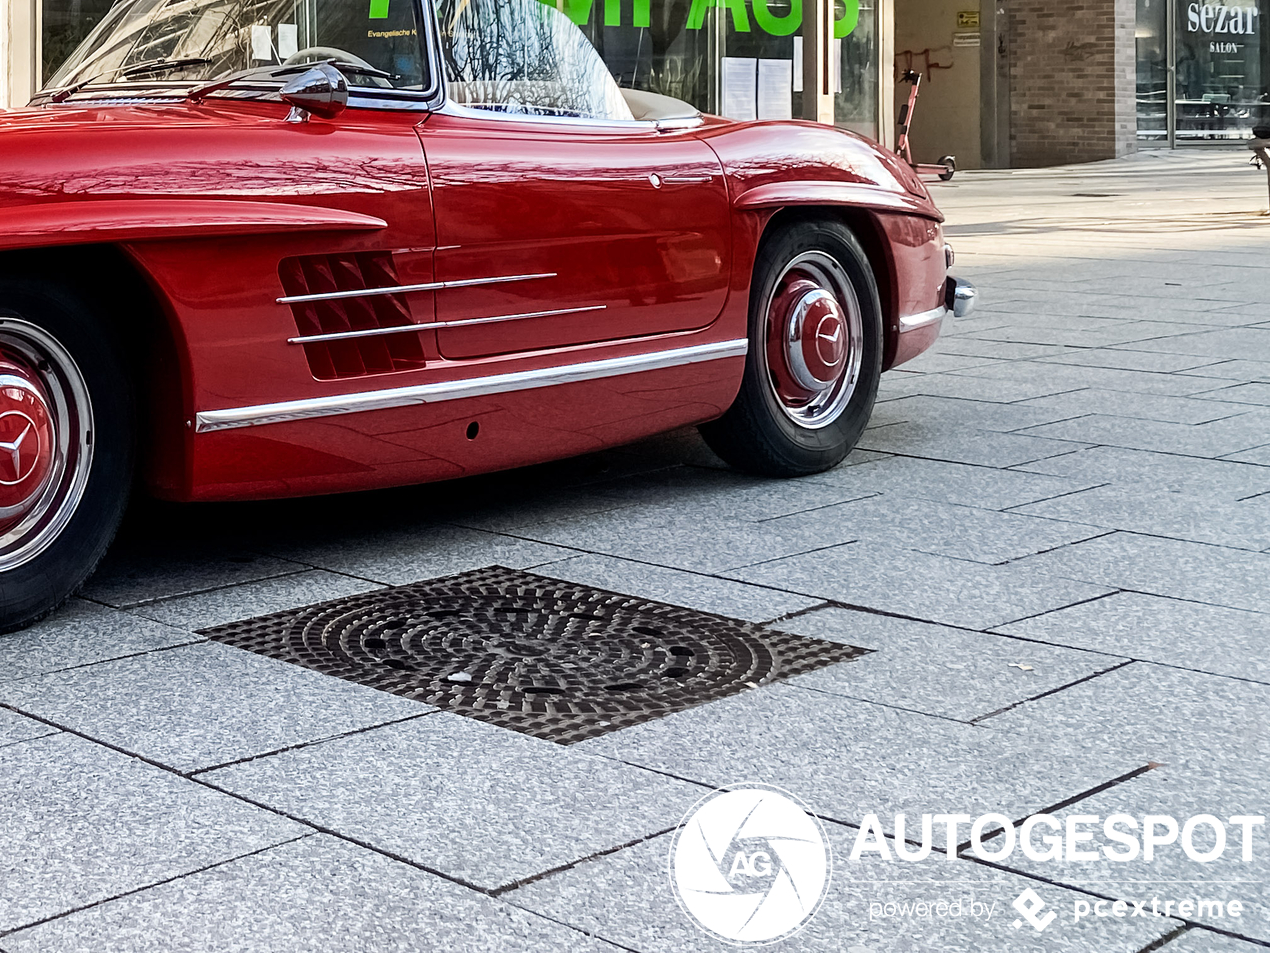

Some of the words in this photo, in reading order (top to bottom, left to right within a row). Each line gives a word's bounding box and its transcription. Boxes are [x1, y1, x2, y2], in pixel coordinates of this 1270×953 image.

[1187, 2, 1259, 35] sezar
[367, 29, 410, 39] Evangelische
[1209, 41, 1238, 54] SALON
